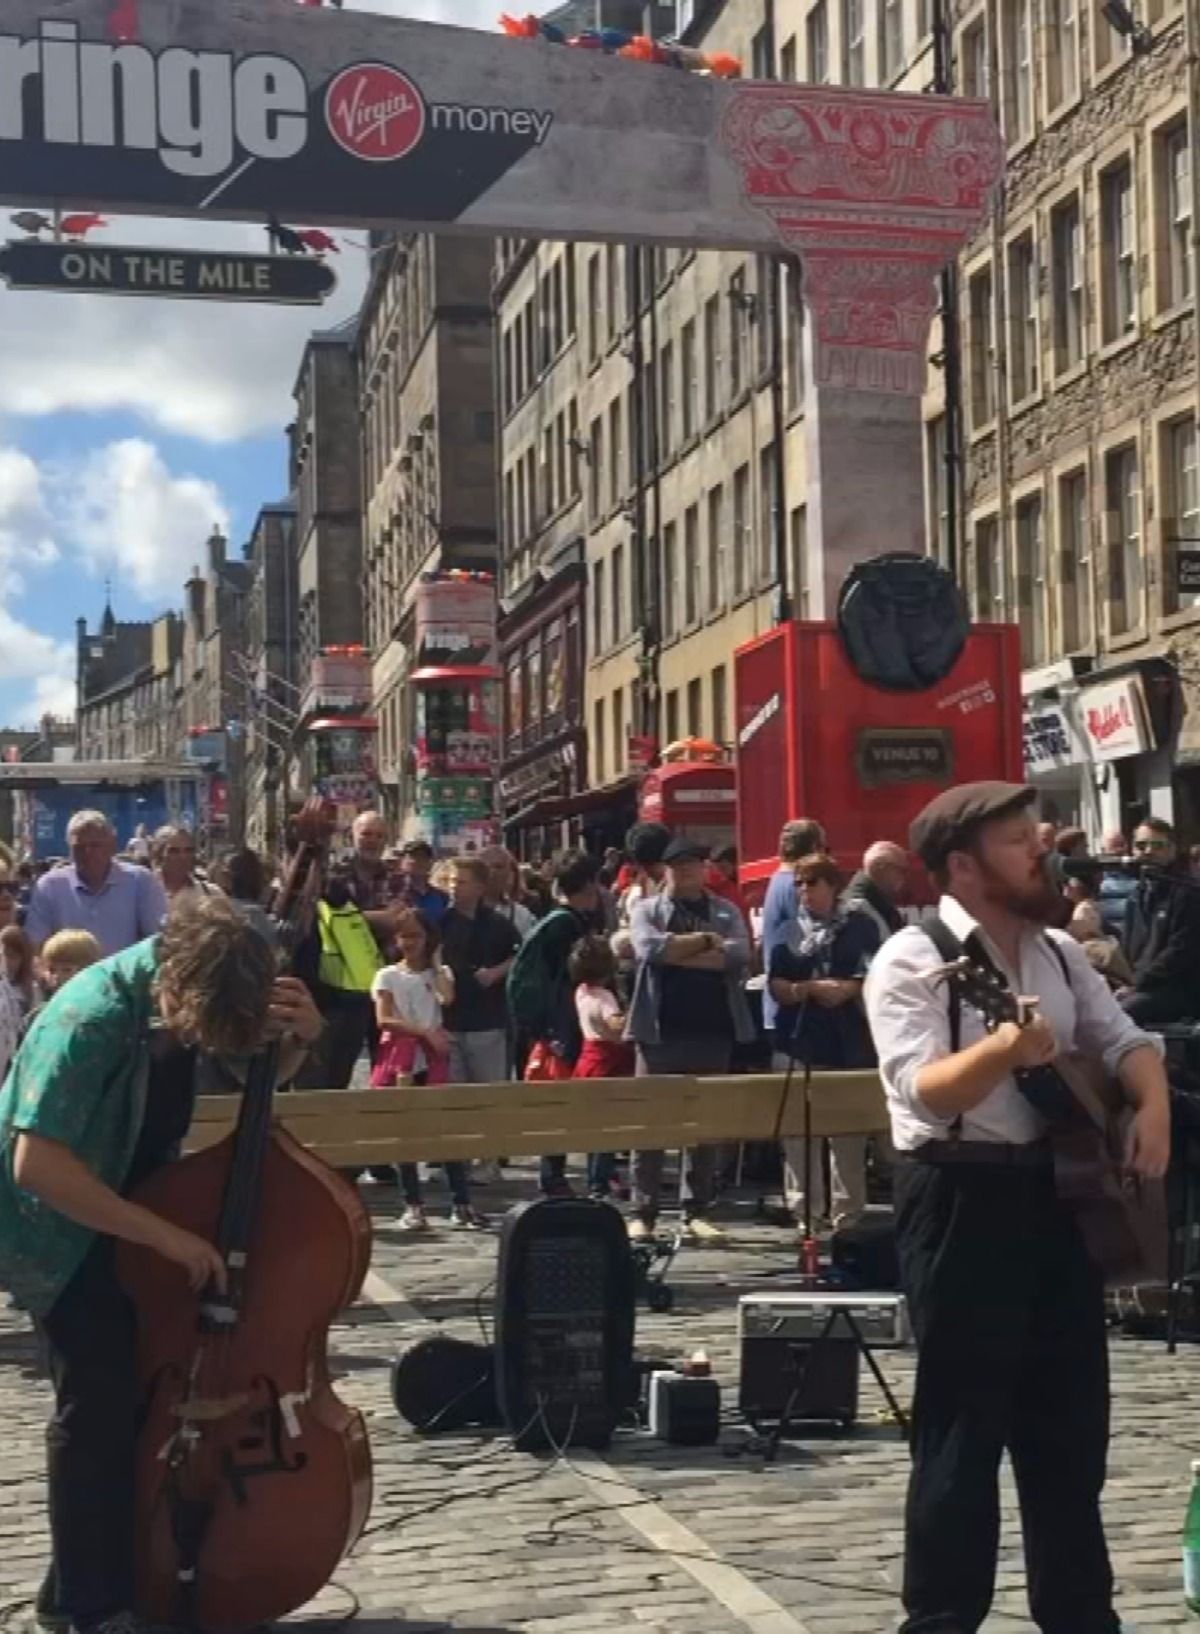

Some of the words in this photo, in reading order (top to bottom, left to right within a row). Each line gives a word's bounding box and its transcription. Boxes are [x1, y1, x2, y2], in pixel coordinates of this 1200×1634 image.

[0, 20, 308, 176] ringe
[336, 76, 413, 146] Virgin
[431, 104, 551, 143] money
[60, 253, 112, 281] ON
[123, 256, 186, 285] THE
[198, 261, 272, 289] MILE
